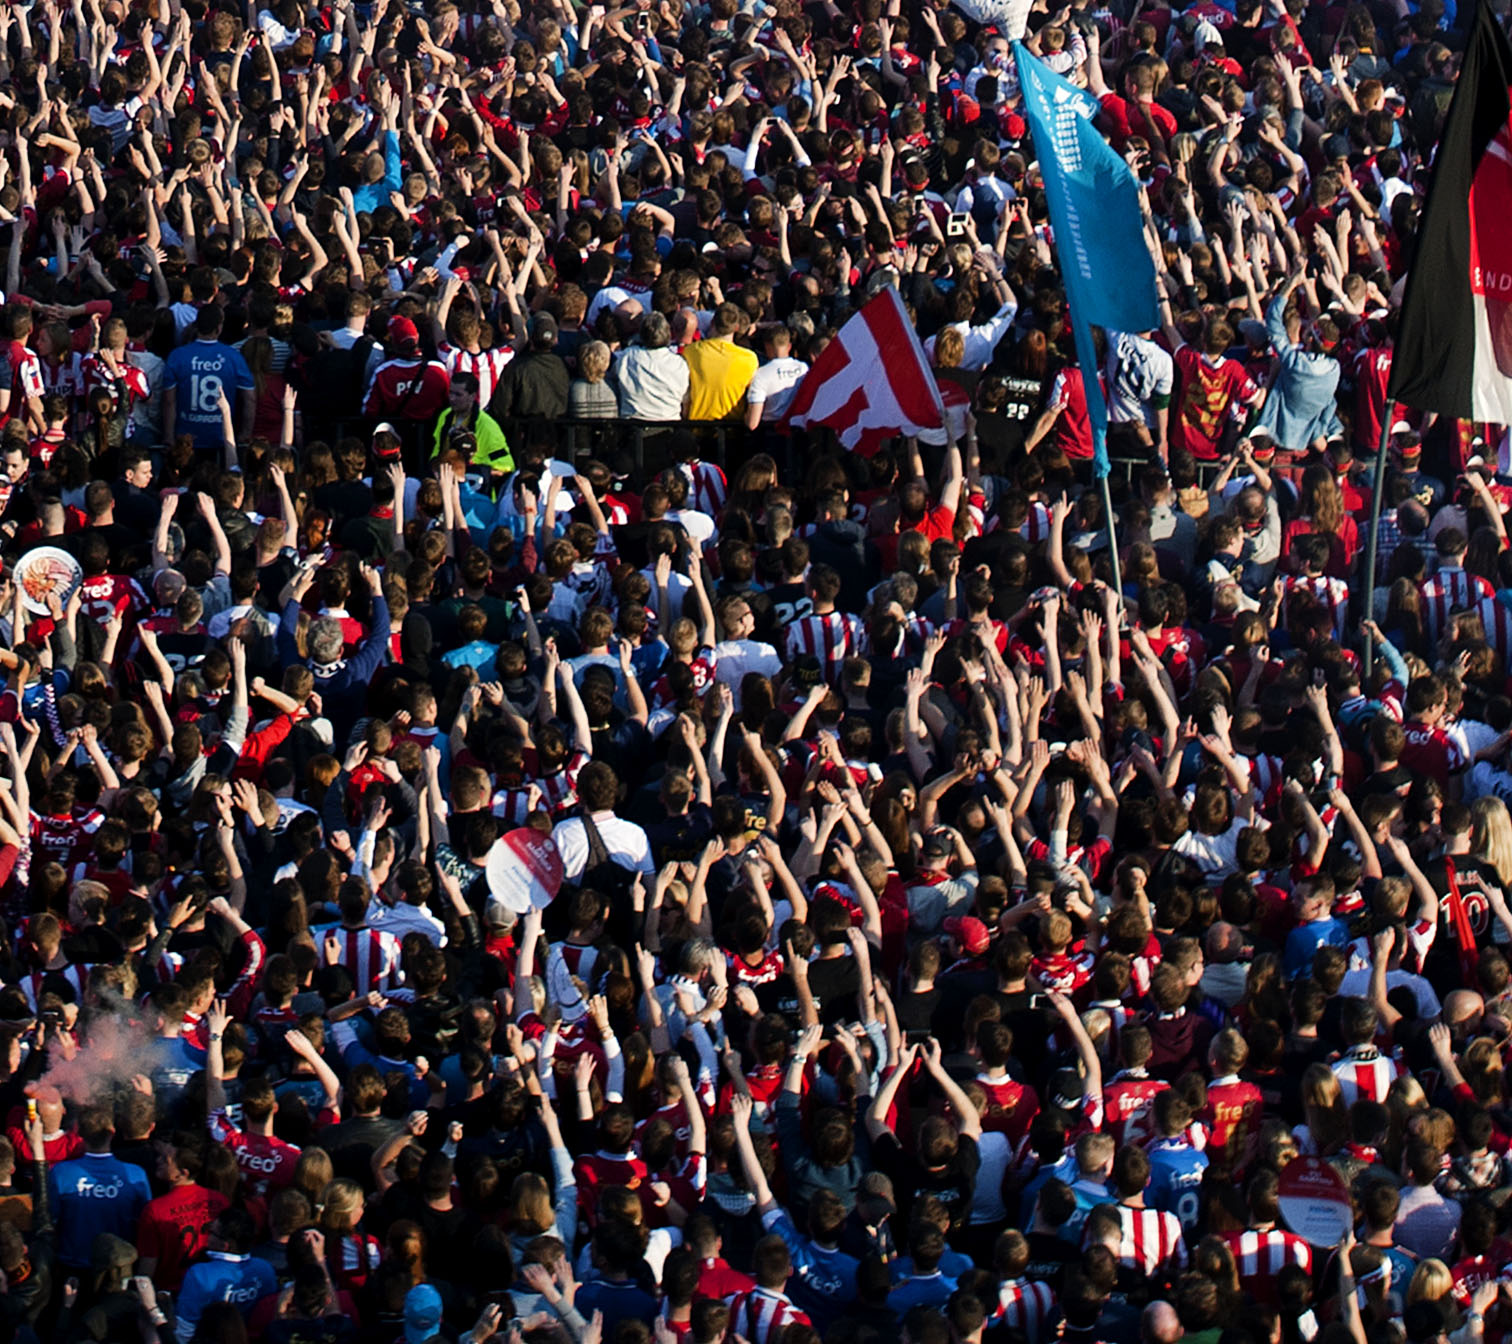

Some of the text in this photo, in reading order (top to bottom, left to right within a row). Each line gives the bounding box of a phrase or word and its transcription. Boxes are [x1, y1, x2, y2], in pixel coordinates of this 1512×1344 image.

[191, 354, 226, 371] freo
[191, 374, 223, 411] 18
[40, 831, 80, 847] freo
[234, 1145, 283, 1173] freo
[76, 1174, 124, 1199] freo
[223, 1277, 262, 1303] freo
